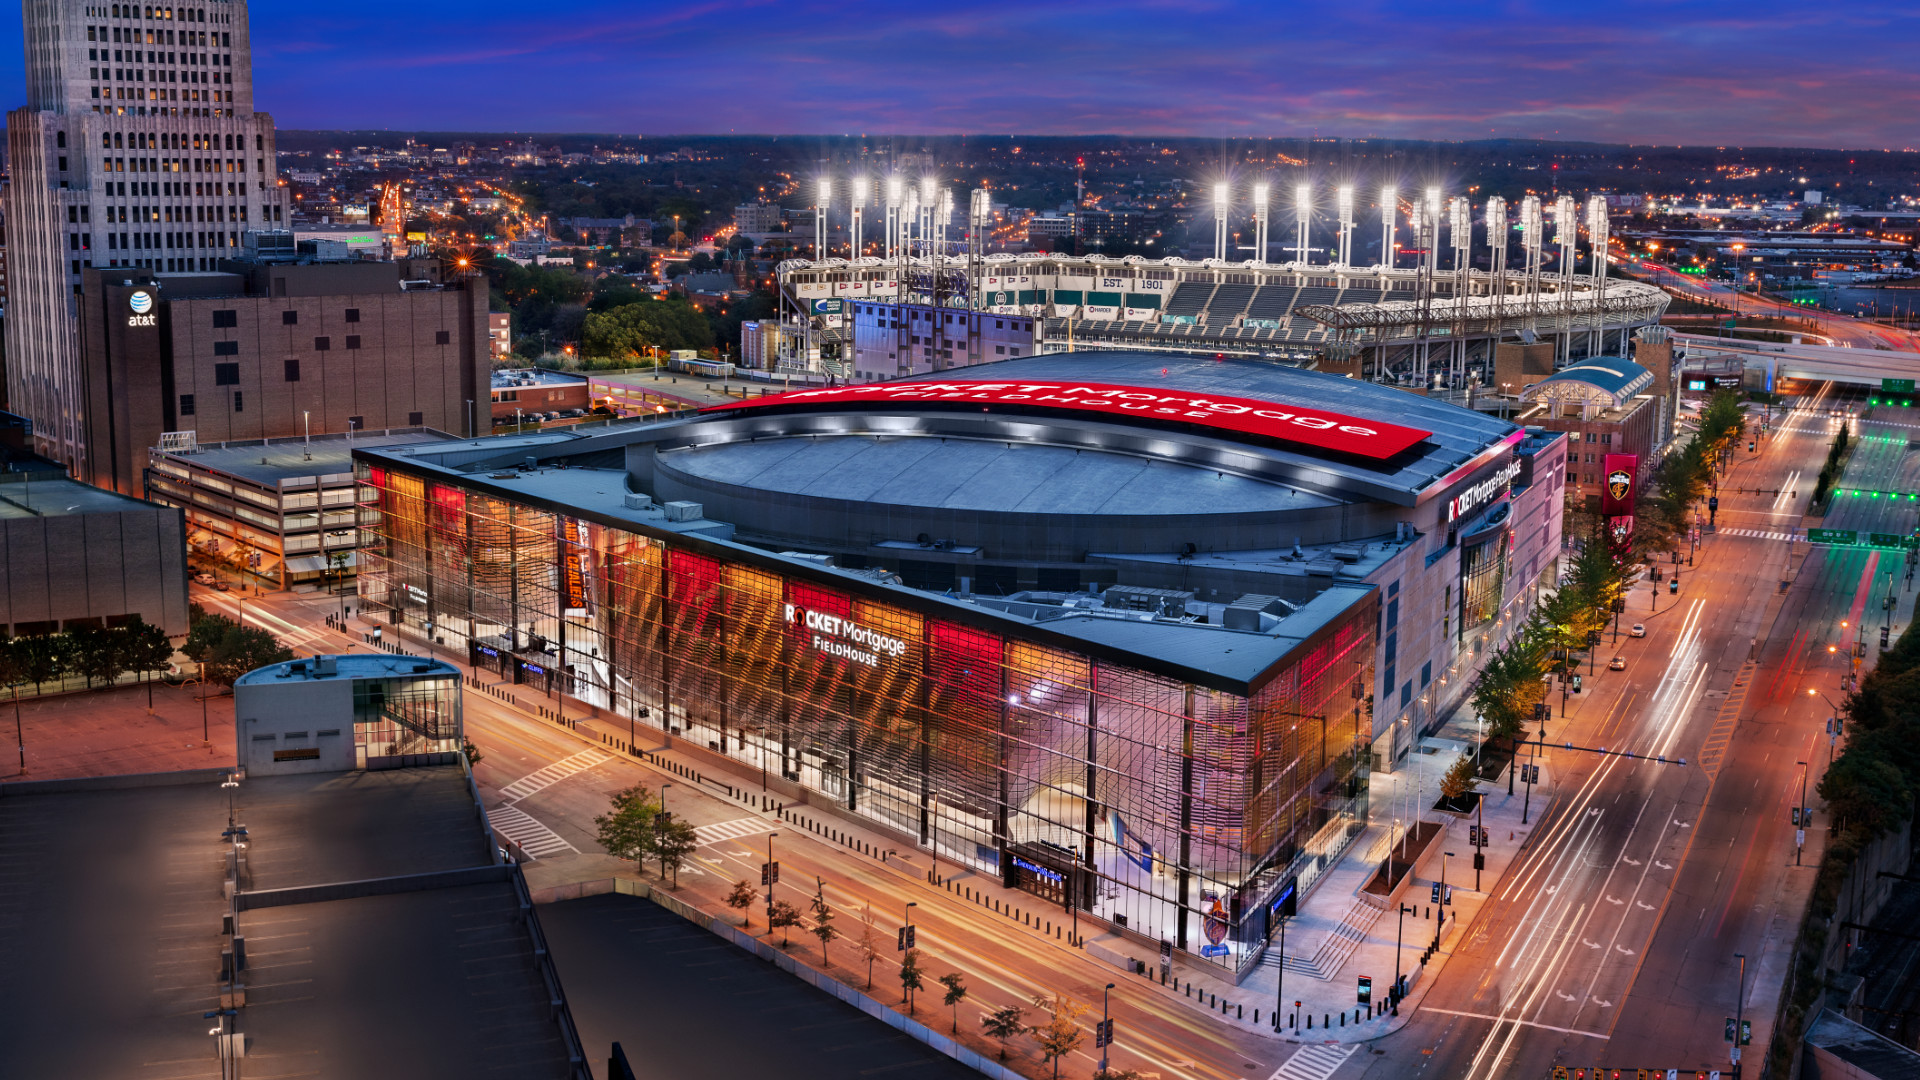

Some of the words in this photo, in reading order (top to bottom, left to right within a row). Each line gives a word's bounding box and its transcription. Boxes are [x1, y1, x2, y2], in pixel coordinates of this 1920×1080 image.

[1103, 278, 1124, 288] EST.
[1141, 280, 1163, 289] 1901
[128, 313, 155, 326] at&t
[1062, 386, 1378, 436] Mortgage
[1448, 486, 1474, 523] ROCKET
[1473, 477, 1497, 503] Mortgage
[785, 603, 842, 635] ROCKET
[843, 620, 905, 657] Mortgage
[482, 647, 498, 658] CLIFFS
[527, 664, 544, 675] CLIFFS
